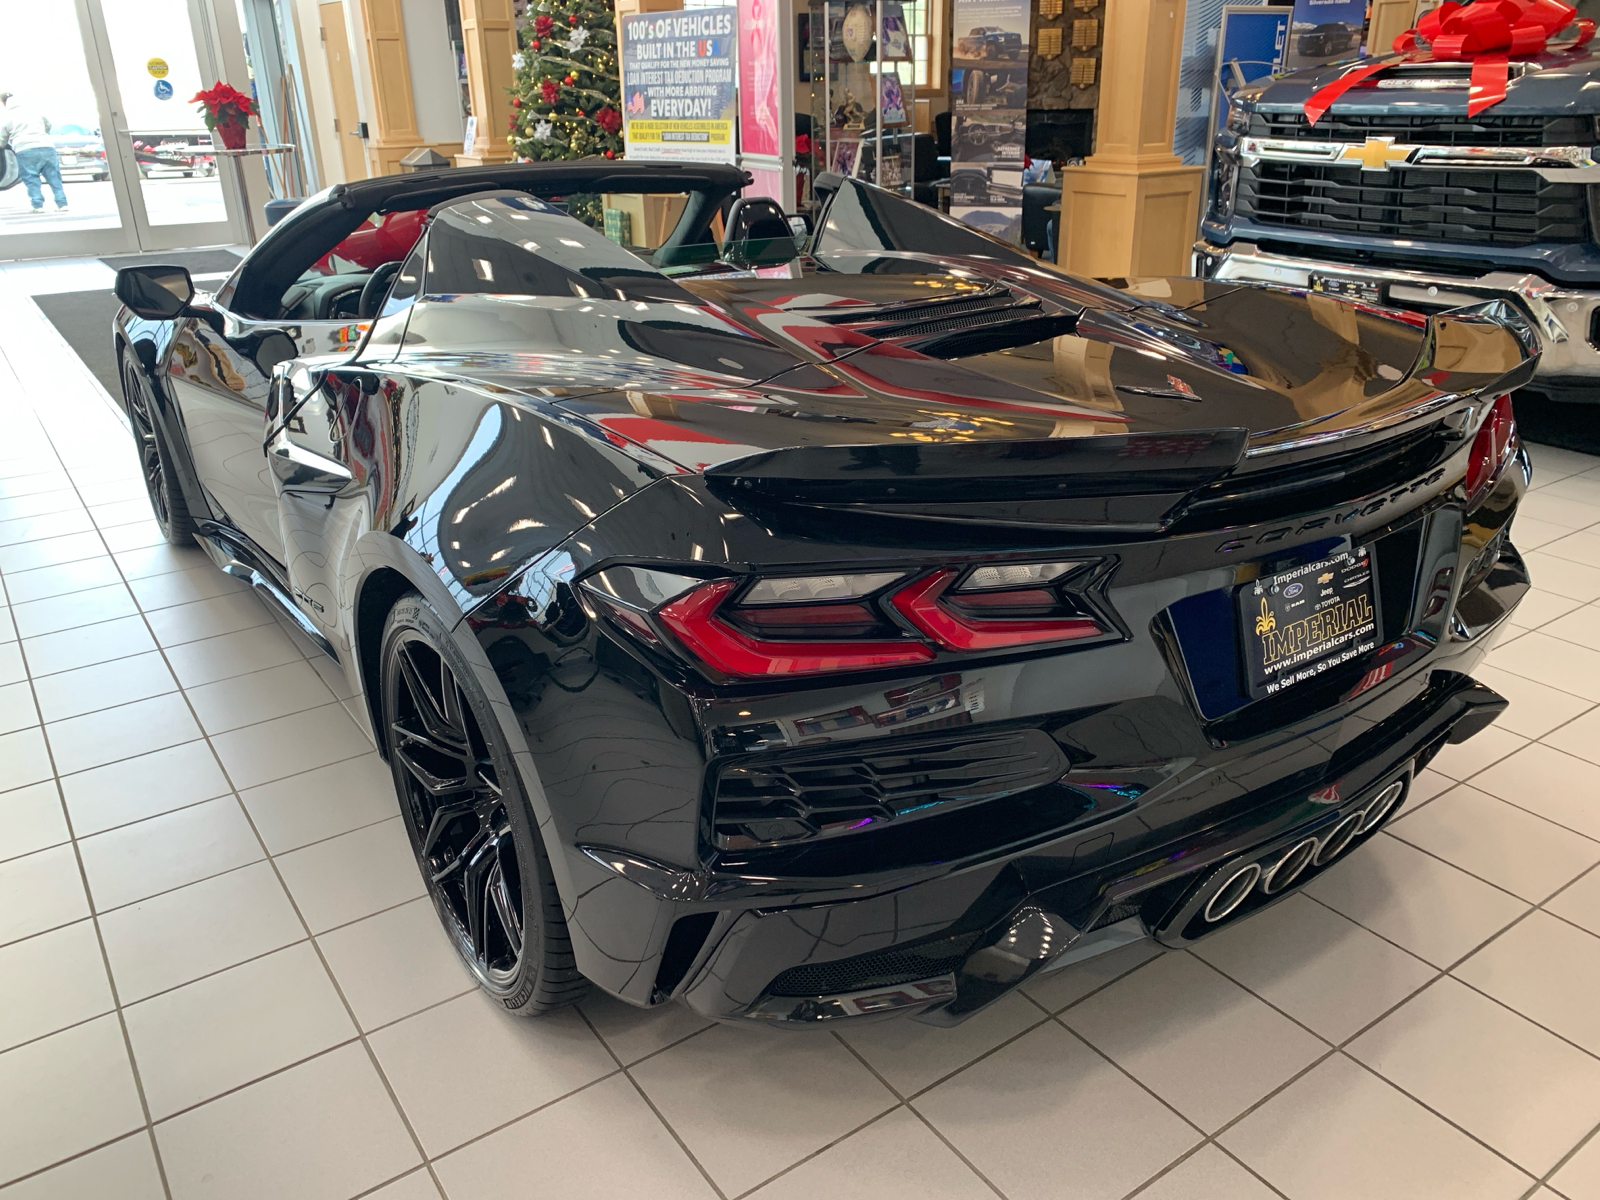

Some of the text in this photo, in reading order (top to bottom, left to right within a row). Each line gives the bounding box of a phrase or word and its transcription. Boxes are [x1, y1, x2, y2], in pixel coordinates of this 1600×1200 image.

[628, 20, 654, 40] 100's
[656, 19, 671, 39] OF
[673, 14, 731, 37] VEHICLES
[637, 40, 720, 60] BUILT IN THE USA
[710, 58, 729, 66] SAVING
[627, 72, 640, 85] LOAN
[641, 71, 663, 84] INTEREST
[665, 71, 674, 84] TAX
[675, 70, 704, 84] DEDUCTION
[705, 69, 732, 83] PROGRAM
[648, 87, 664, 97] WITH
[665, 86, 683, 97] MORE
[685, 86, 717, 96] ARRIVING
[650, 99, 711, 117] EVERYDAY!
[1216, 468, 1446, 554] CORVETTE
[1273, 552, 1348, 584] Imperialcars.com
[1320, 587, 1333, 596] Jeep
[1291, 599, 1305, 608] RAM
[1321, 596, 1340, 608] TOYOTA
[1262, 594, 1373, 665] IMPERIAL
[1264, 622, 1374, 675] www.imperialcars.com
[1266, 642, 1374, 694] We Sell More, So You Save More
